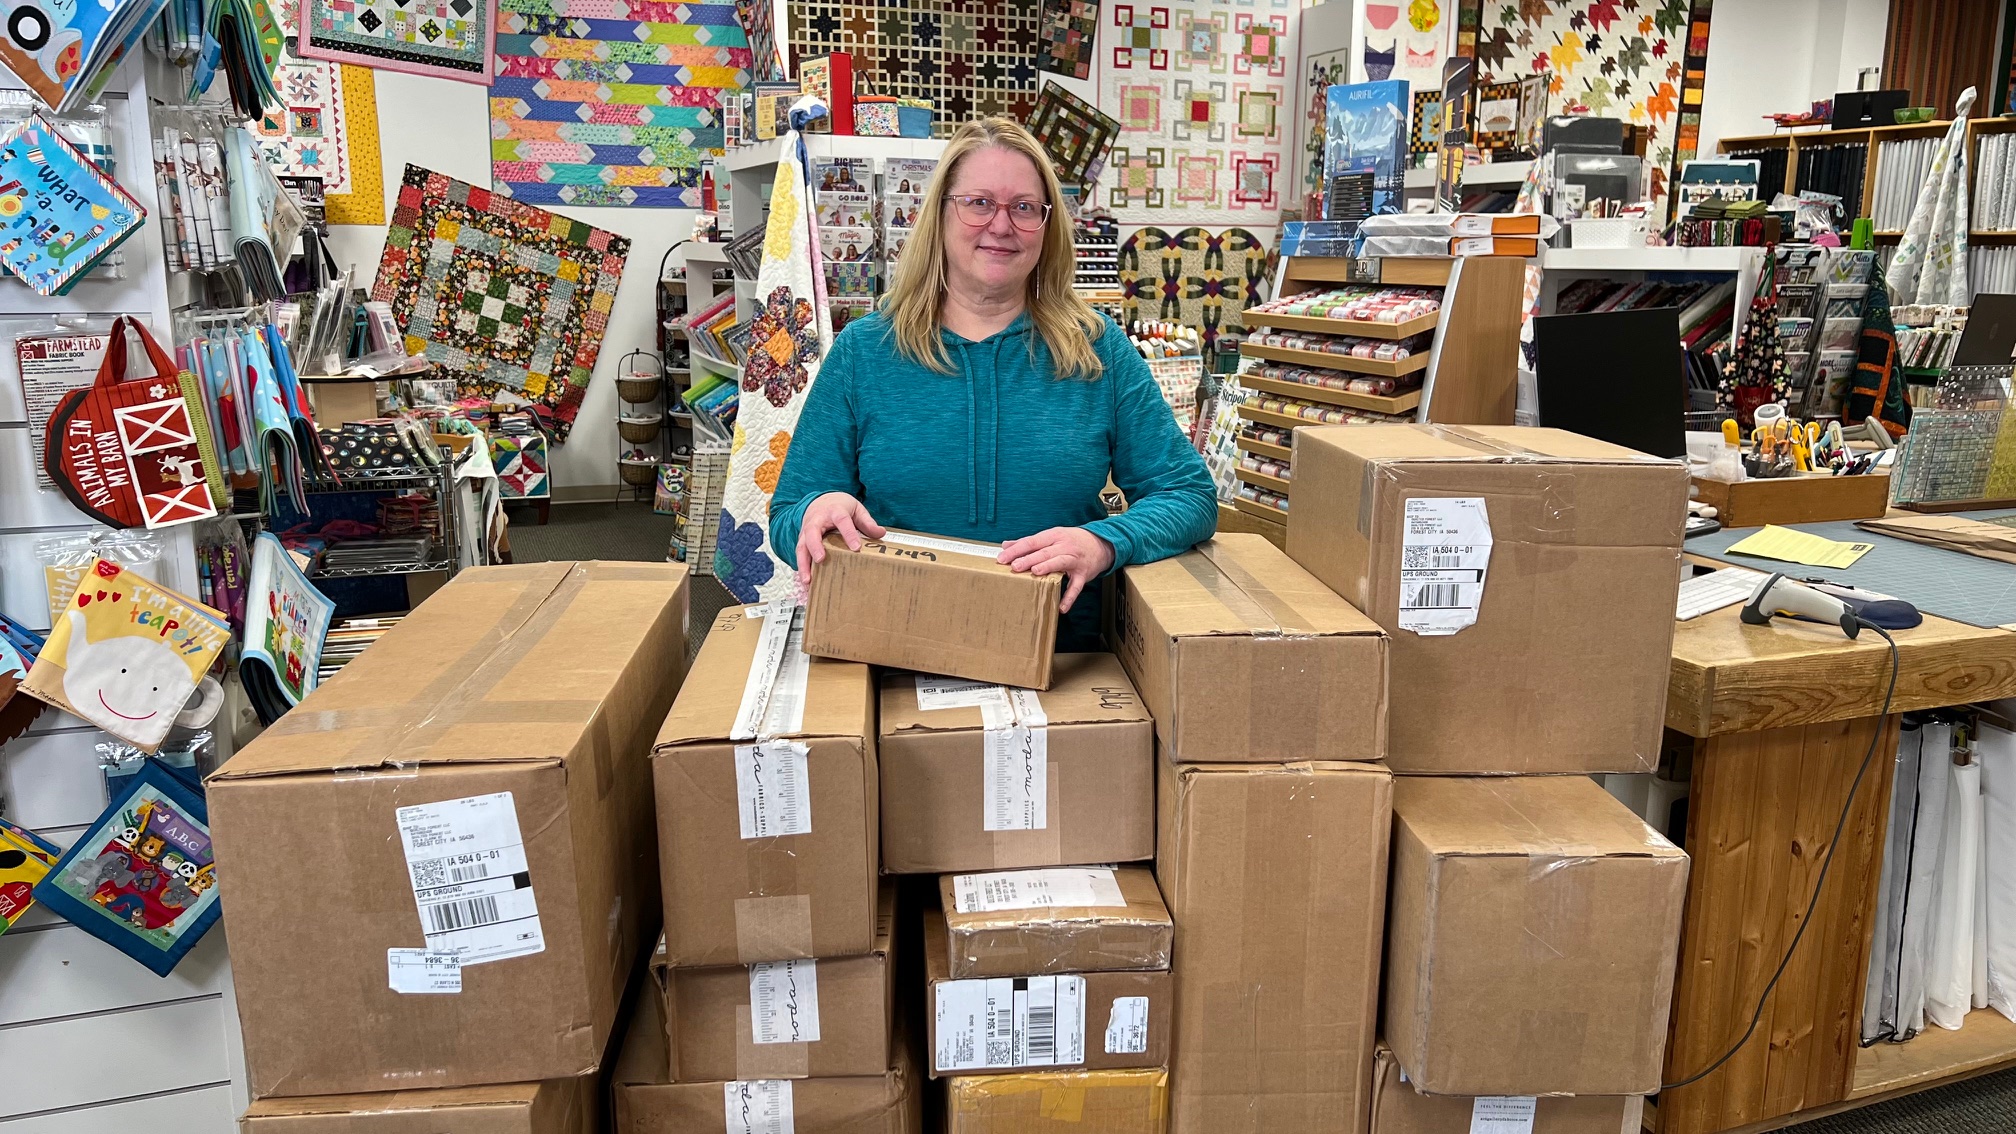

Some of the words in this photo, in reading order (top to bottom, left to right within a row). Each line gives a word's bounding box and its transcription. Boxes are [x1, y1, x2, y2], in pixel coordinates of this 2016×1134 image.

[1348, 90, 1374, 100] AURIFIL
[834, 158, 848, 167] BIG
[902, 164, 932, 172] CHRISTMAS
[47, 338, 101, 352] FARMSTEAD
[70, 420, 92, 437] IN
[94, 431, 123, 463] BARN
[69, 442, 115, 507] ANIMALS
[104, 467, 130, 488] MY
[52, 569, 80, 614] little
[129, 585, 166, 609] I'm
[169, 605, 181, 620] a
[184, 611, 222, 651] little
[129, 604, 202, 655] teapot!
[1022, 729, 1032, 796] moda
[165, 826, 199, 851] A,B,C
[413, 839, 434, 848] FOREST
[435, 837, 447, 845] CITY
[447, 858, 456, 866] IA
[458, 855, 474, 865] 504
[417, 891, 432, 899] UPS
[433, 886, 463, 896] GROUND
